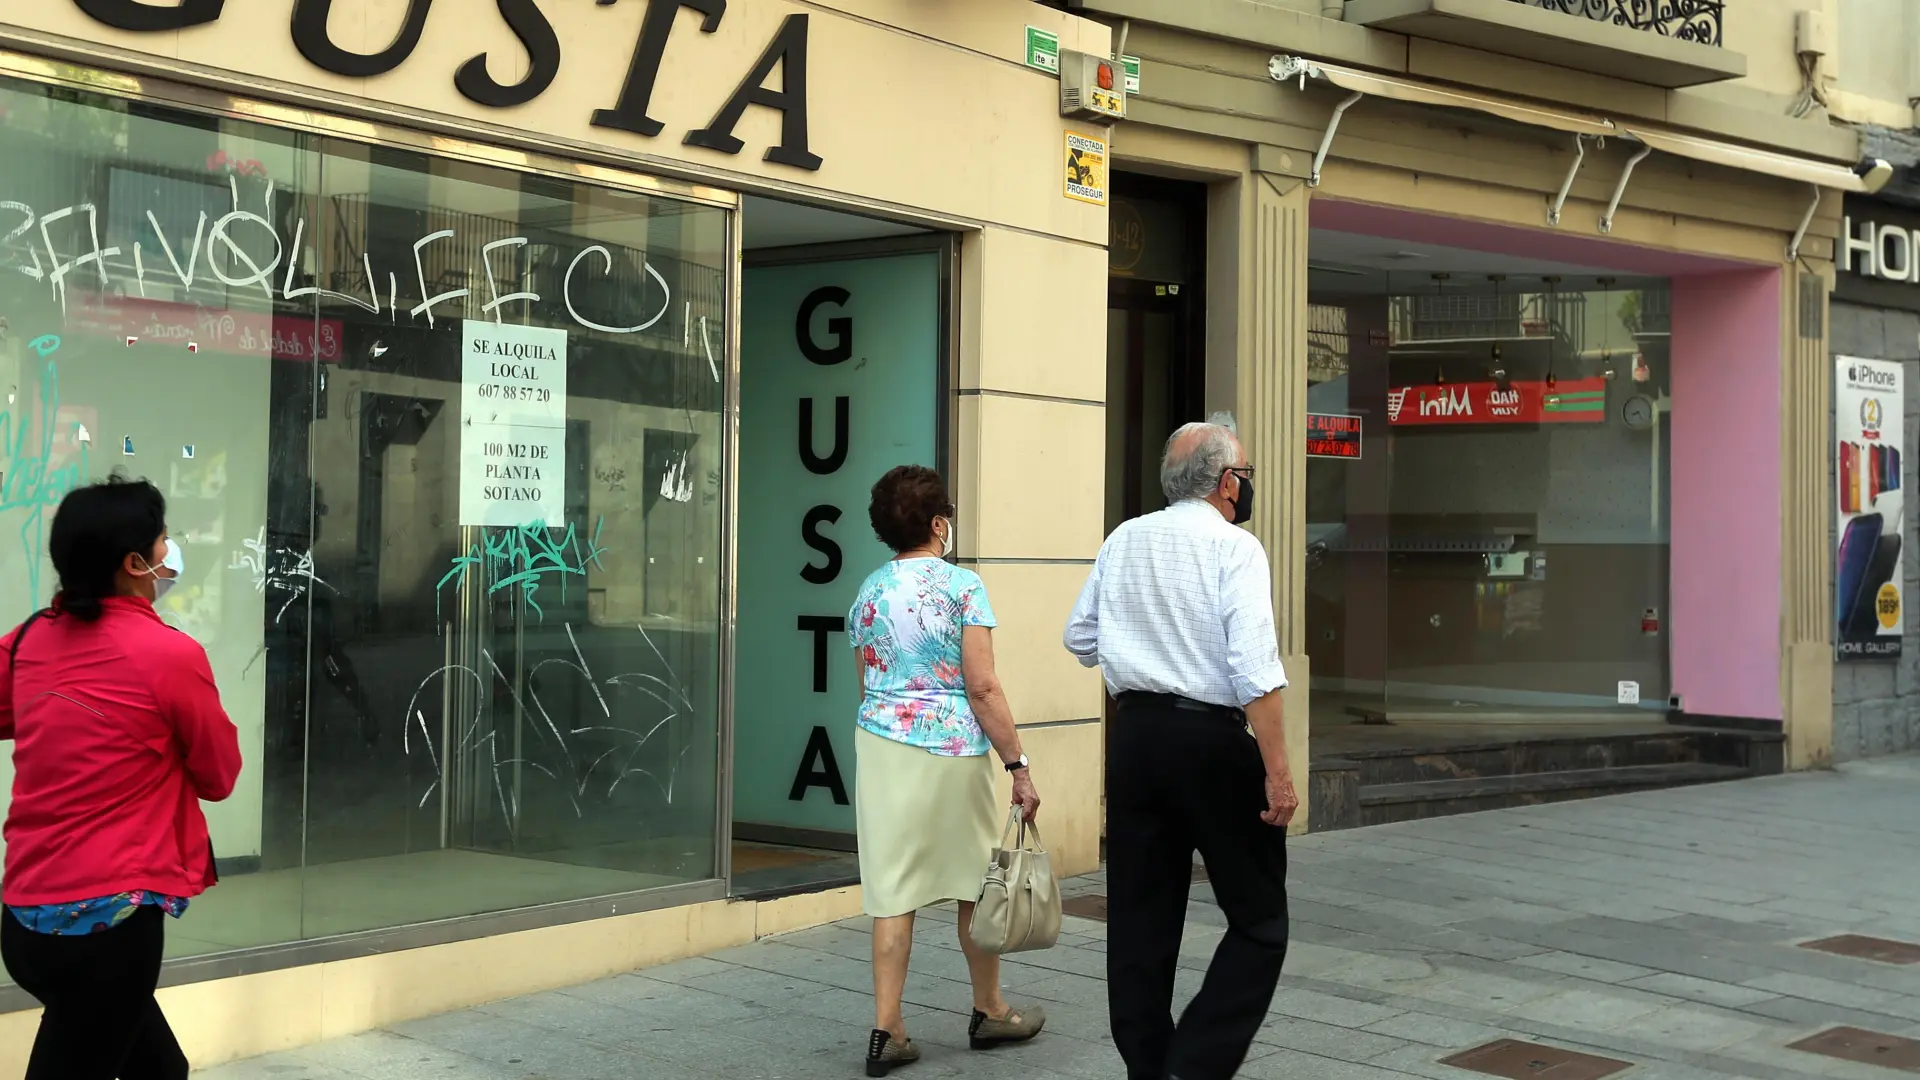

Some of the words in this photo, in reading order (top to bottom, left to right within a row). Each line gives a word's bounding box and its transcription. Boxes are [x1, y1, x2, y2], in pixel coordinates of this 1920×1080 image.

[1035, 53, 1046, 64] ite
[72, 0, 824, 171] STA
[1068, 135, 1104, 151] CONECTADA
[1067, 184, 1103, 199] PROSEGUR
[473, 338, 490, 354] SE
[494, 341, 557, 361] ALQUILA
[491, 362, 539, 380] LOCAL
[1858, 364, 1896, 386] iPhone
[478, 383, 500, 398] 607
[503, 385, 517, 400] 88
[519, 386, 533, 401] 57
[536, 388, 550, 402] 20
[1867, 399, 1876, 422] 2
[1308, 415, 1315, 430] E
[1317, 416, 1360, 433] ALQUILA
[483, 442, 503, 457] 100
[507, 443, 526, 458] M2
[530, 445, 549, 460] DE
[1307, 440, 1318, 454] 07
[485, 463, 541, 480] PLANTA
[483, 485, 541, 502] SOTANO
[788, 285, 853, 806] GUSTA
[1839, 642, 1863, 653] HOME
[1865, 641, 1900, 653] GALLERY
